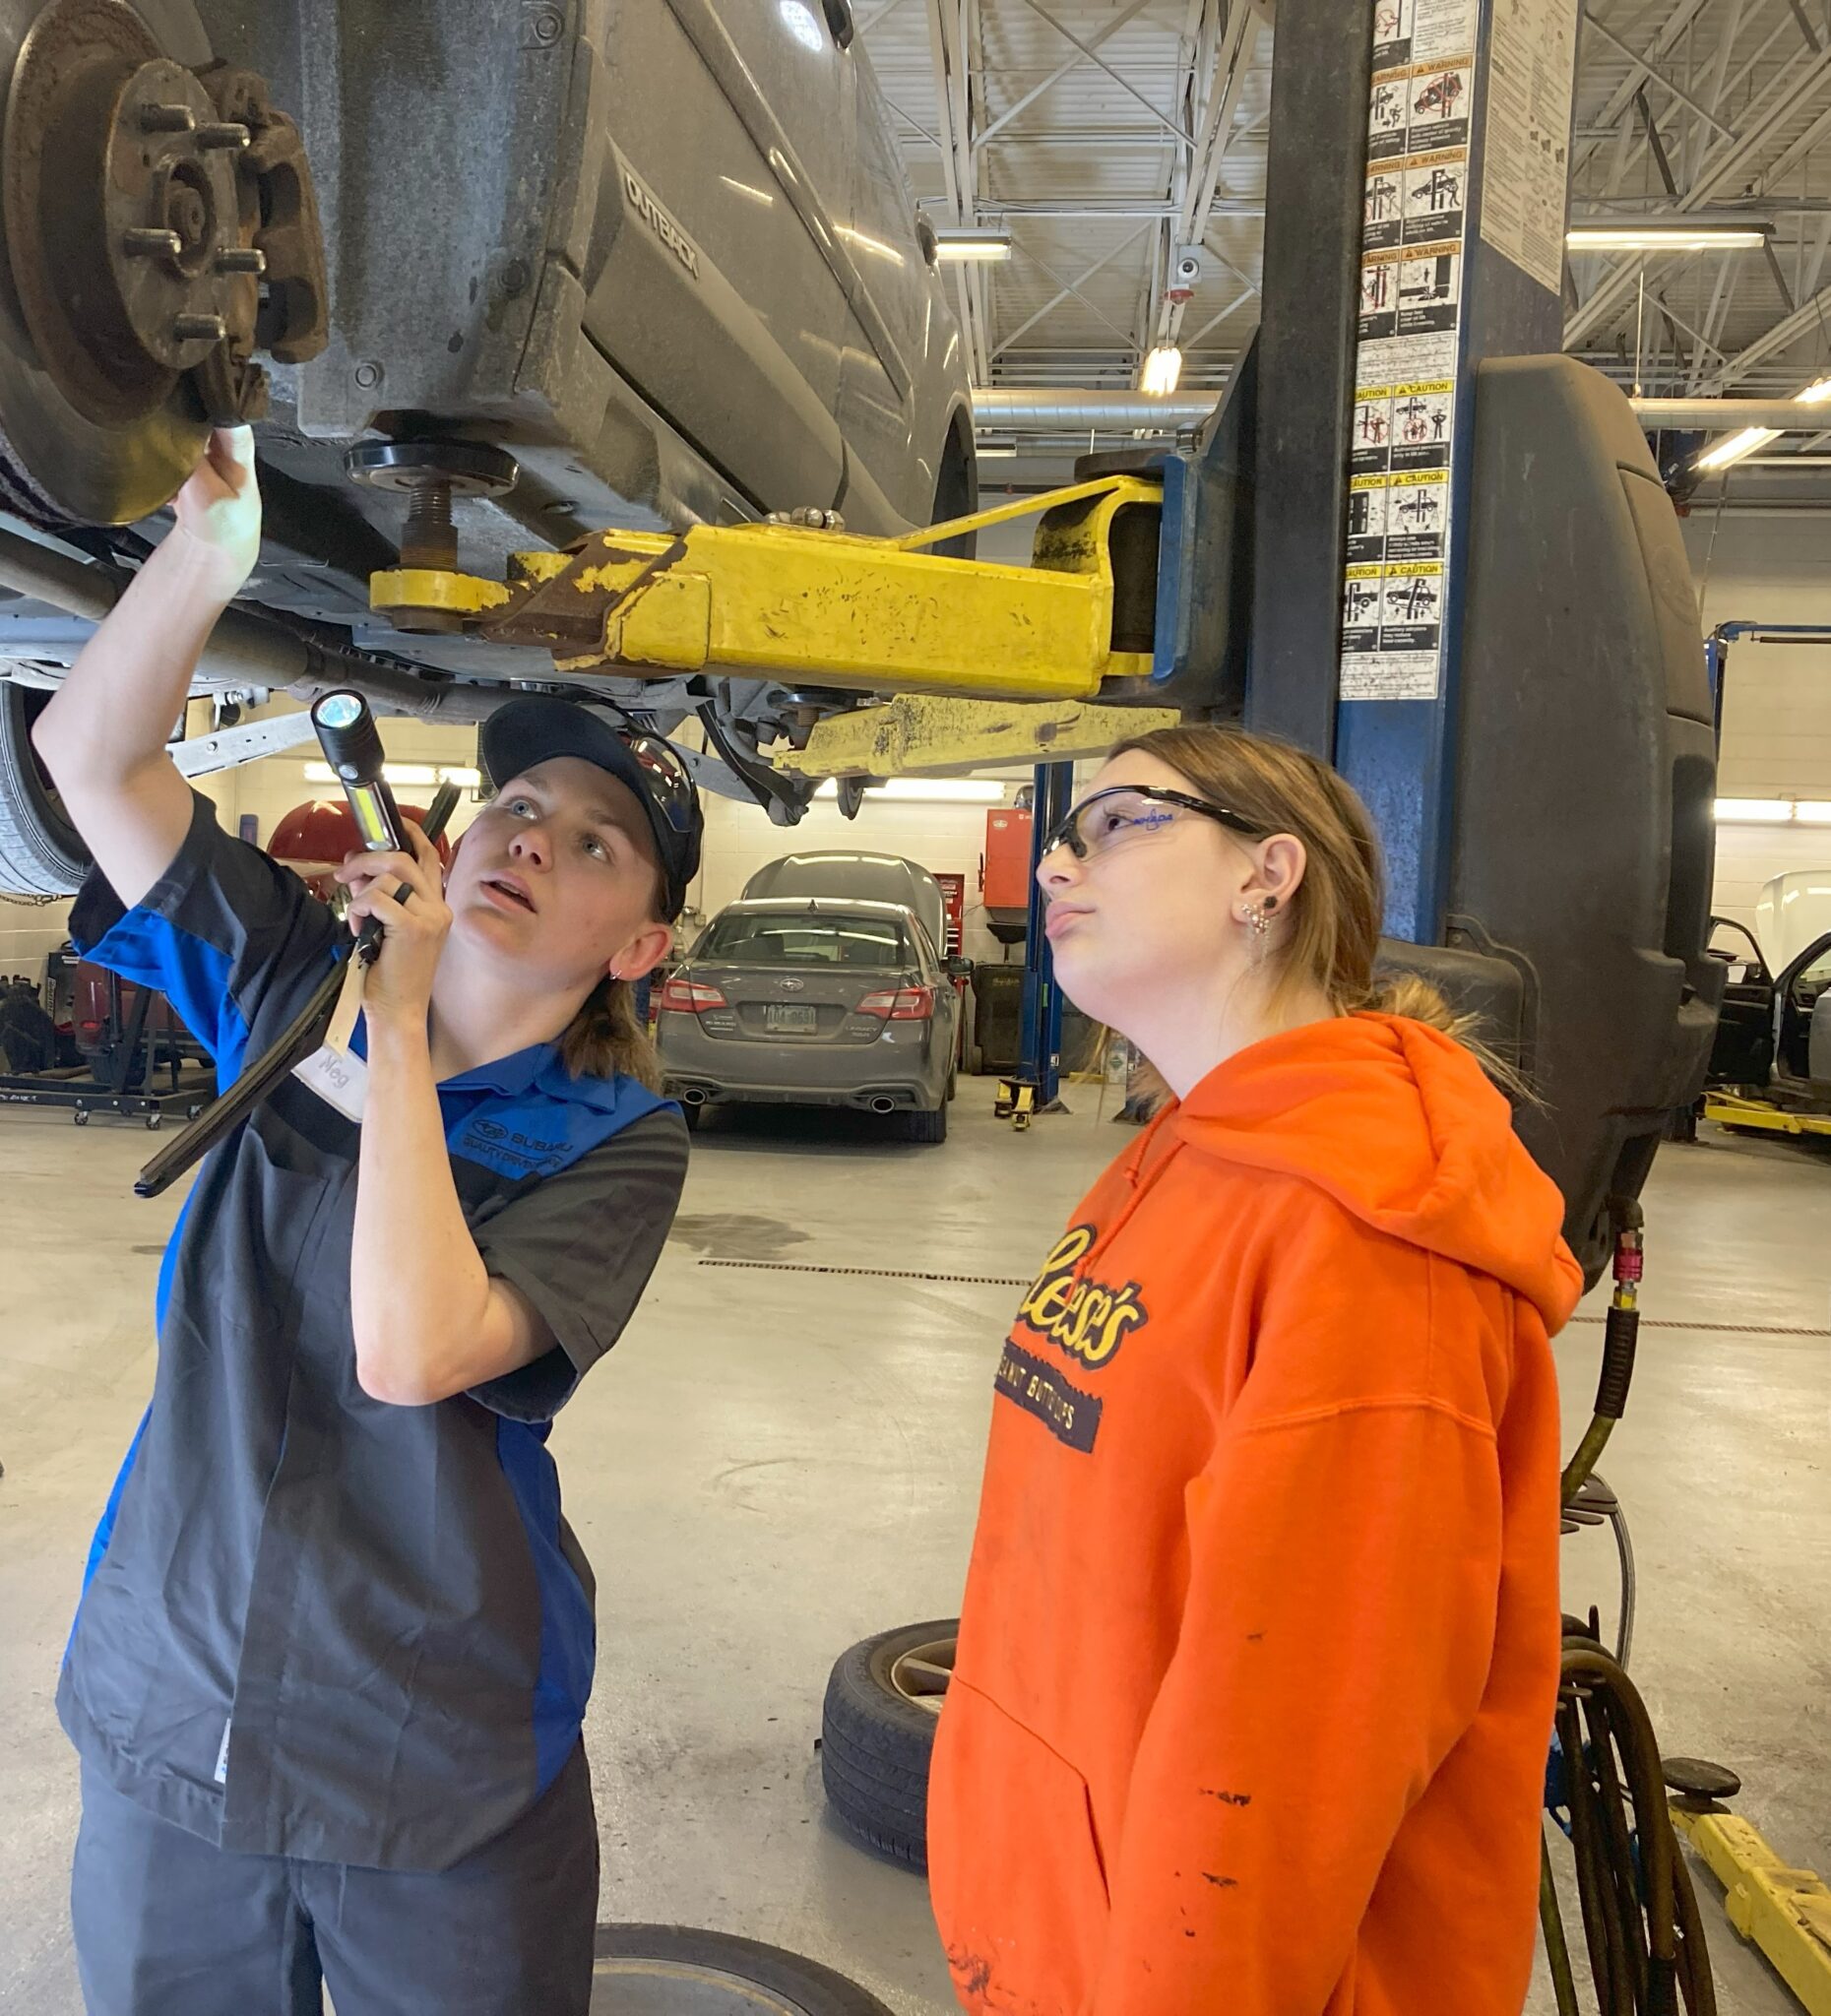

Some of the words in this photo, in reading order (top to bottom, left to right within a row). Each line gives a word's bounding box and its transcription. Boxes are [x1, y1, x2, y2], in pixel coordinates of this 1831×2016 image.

[1427, 57, 1469, 72] WARNING
[1421, 151, 1463, 163] WARNING
[1369, 160, 1401, 173] ARNING
[625, 172, 700, 280] OUTBACK
[1416, 243, 1456, 256] WARNING
[1364, 252, 1398, 265] ARNING
[1357, 389, 1387, 399] AUTION
[1410, 383, 1448, 393] CAUTION
[1354, 477, 1382, 487] AUTION
[1405, 473, 1443, 483] CAUTION
[1348, 568, 1377, 577] AUTION
[1401, 565, 1438, 574] CAUTION
[512, 1132, 574, 1152] SUBARU
